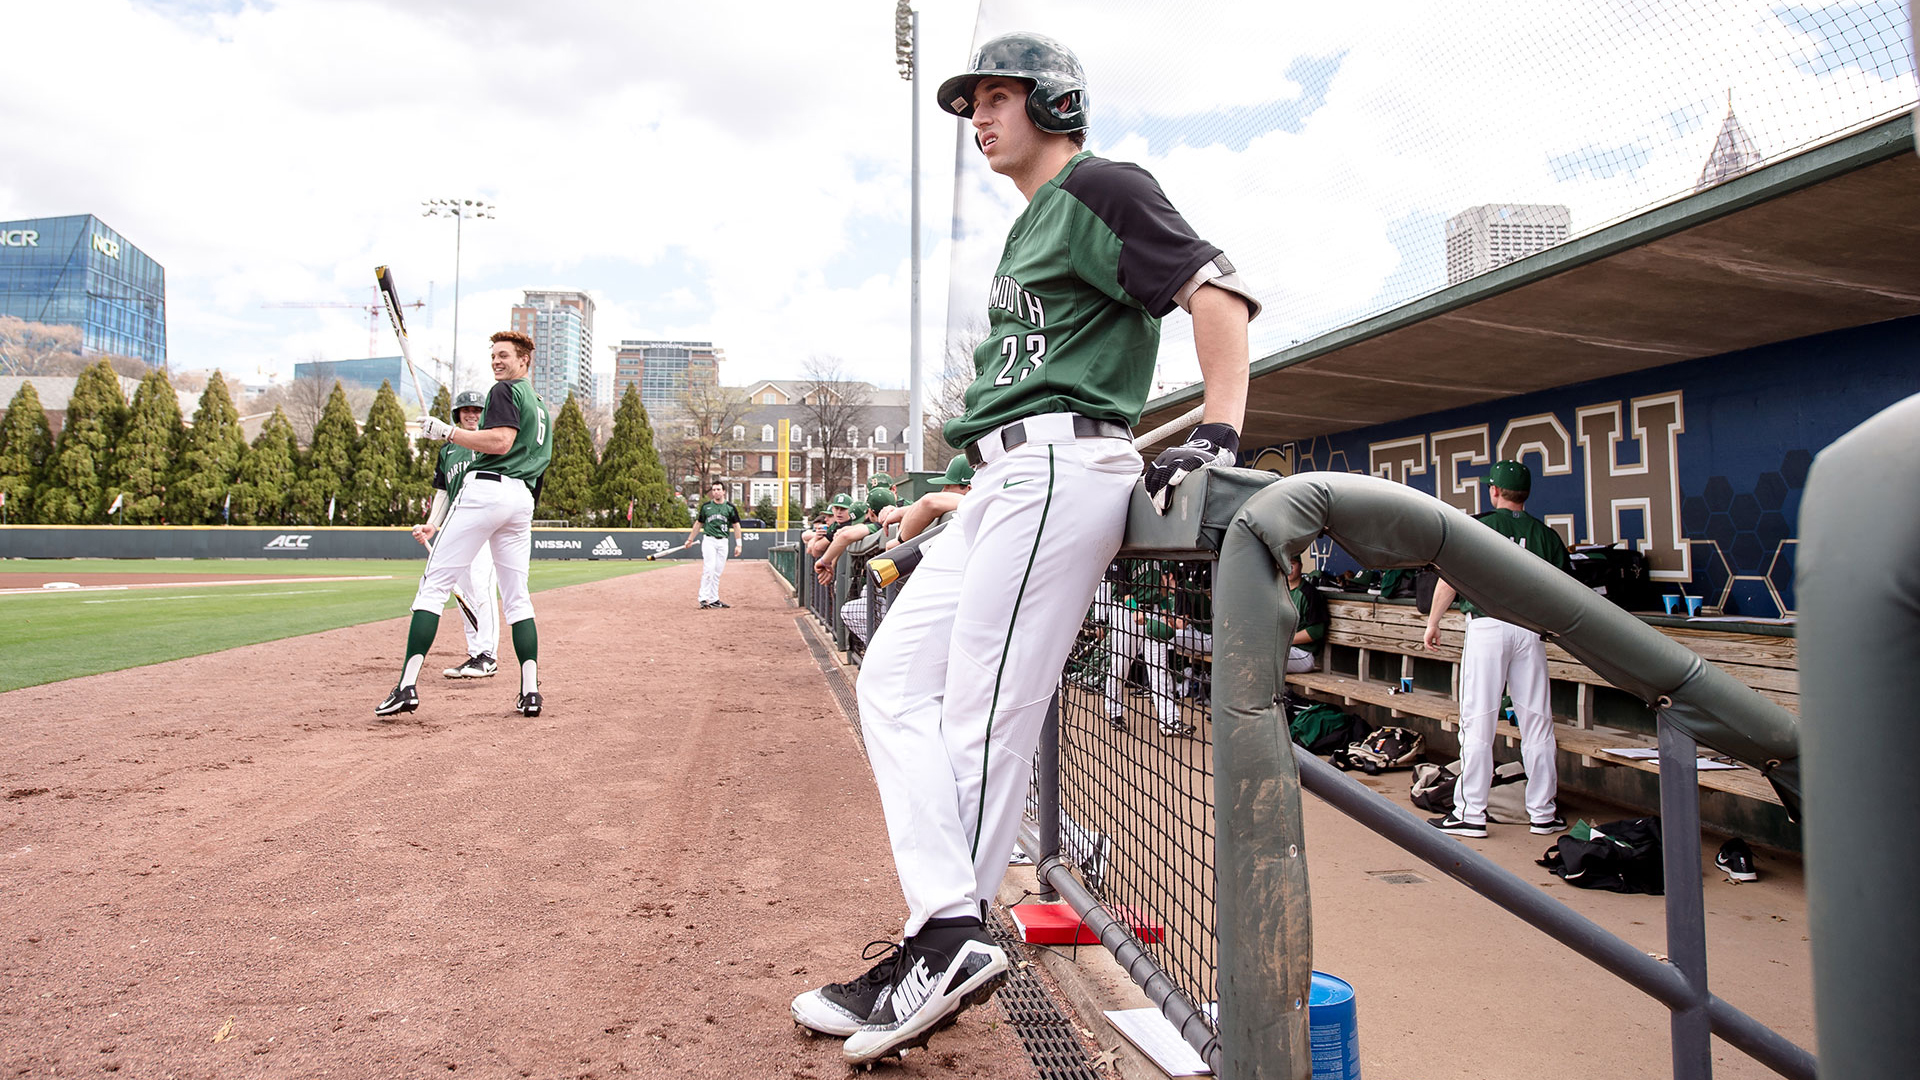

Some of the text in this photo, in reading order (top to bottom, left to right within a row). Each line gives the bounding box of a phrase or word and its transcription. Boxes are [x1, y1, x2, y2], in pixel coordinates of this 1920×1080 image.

[92, 233, 120, 260] NCR
[988, 275, 1045, 329] MOUTH
[994, 333, 1047, 387] 23
[536, 405, 546, 446] 6
[267, 534, 312, 547] ACC
[535, 540, 582, 549] NISSAN
[641, 539, 670, 552] sage
[743, 532, 760, 541] 334
[592, 548, 622, 556] adidas
[891, 955, 935, 1024] NIKE
